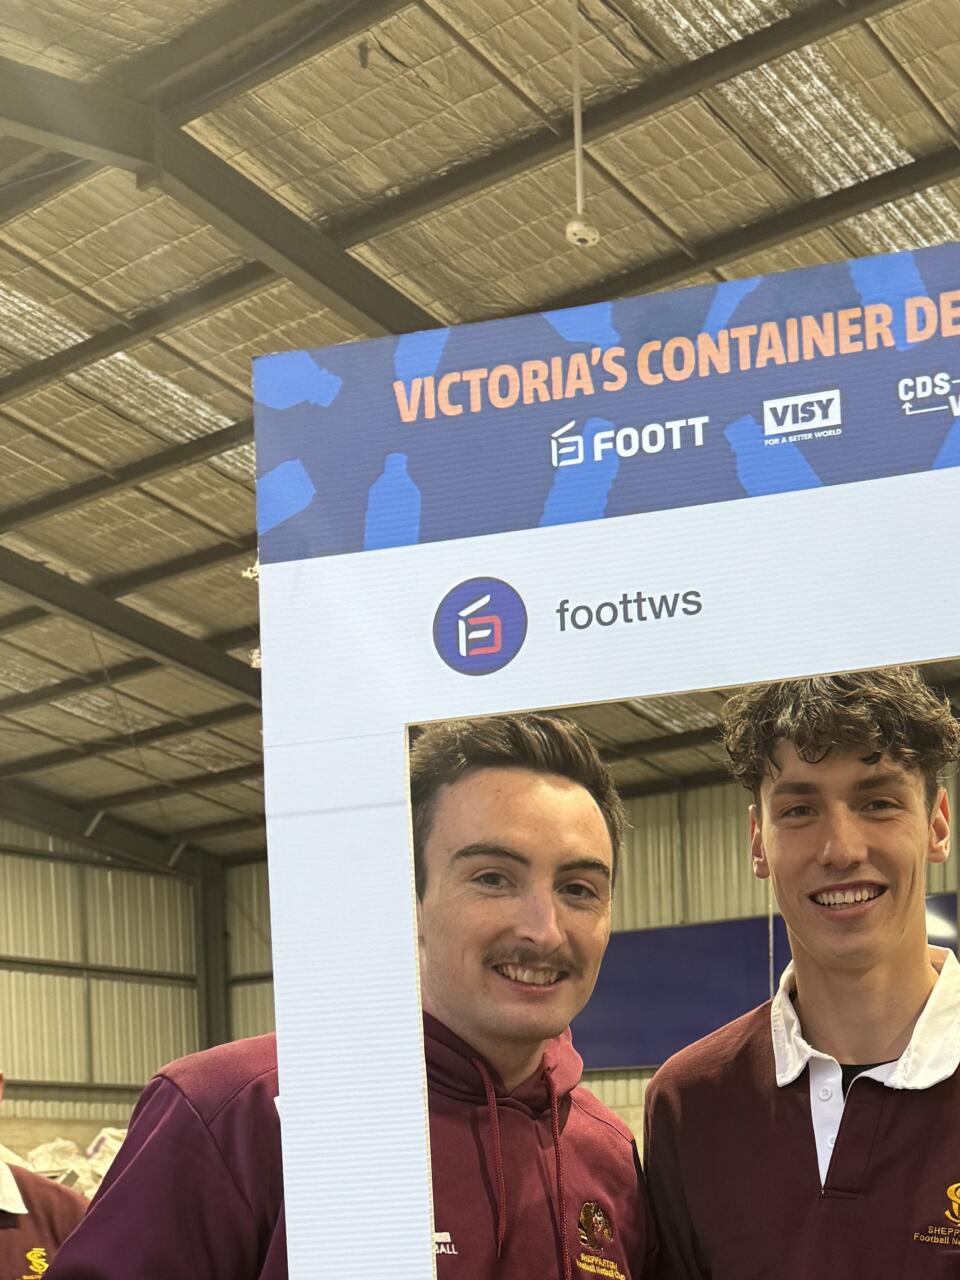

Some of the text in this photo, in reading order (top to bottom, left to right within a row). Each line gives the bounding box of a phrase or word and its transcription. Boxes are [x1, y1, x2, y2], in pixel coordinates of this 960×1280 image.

[393, 346, 628, 423] VICTORIA'S
[636, 302, 896, 386] CONTAINER
[898, 373, 951, 402] CDS
[769, 398, 835, 427] VISY
[593, 416, 709, 461] FOOTT
[764, 438, 780, 446] FOR
[788, 433, 813, 443] BETTER
[814, 428, 842, 439] WORLD
[556, 590, 702, 631] foottws
[913, 1232, 949, 1245] Football
